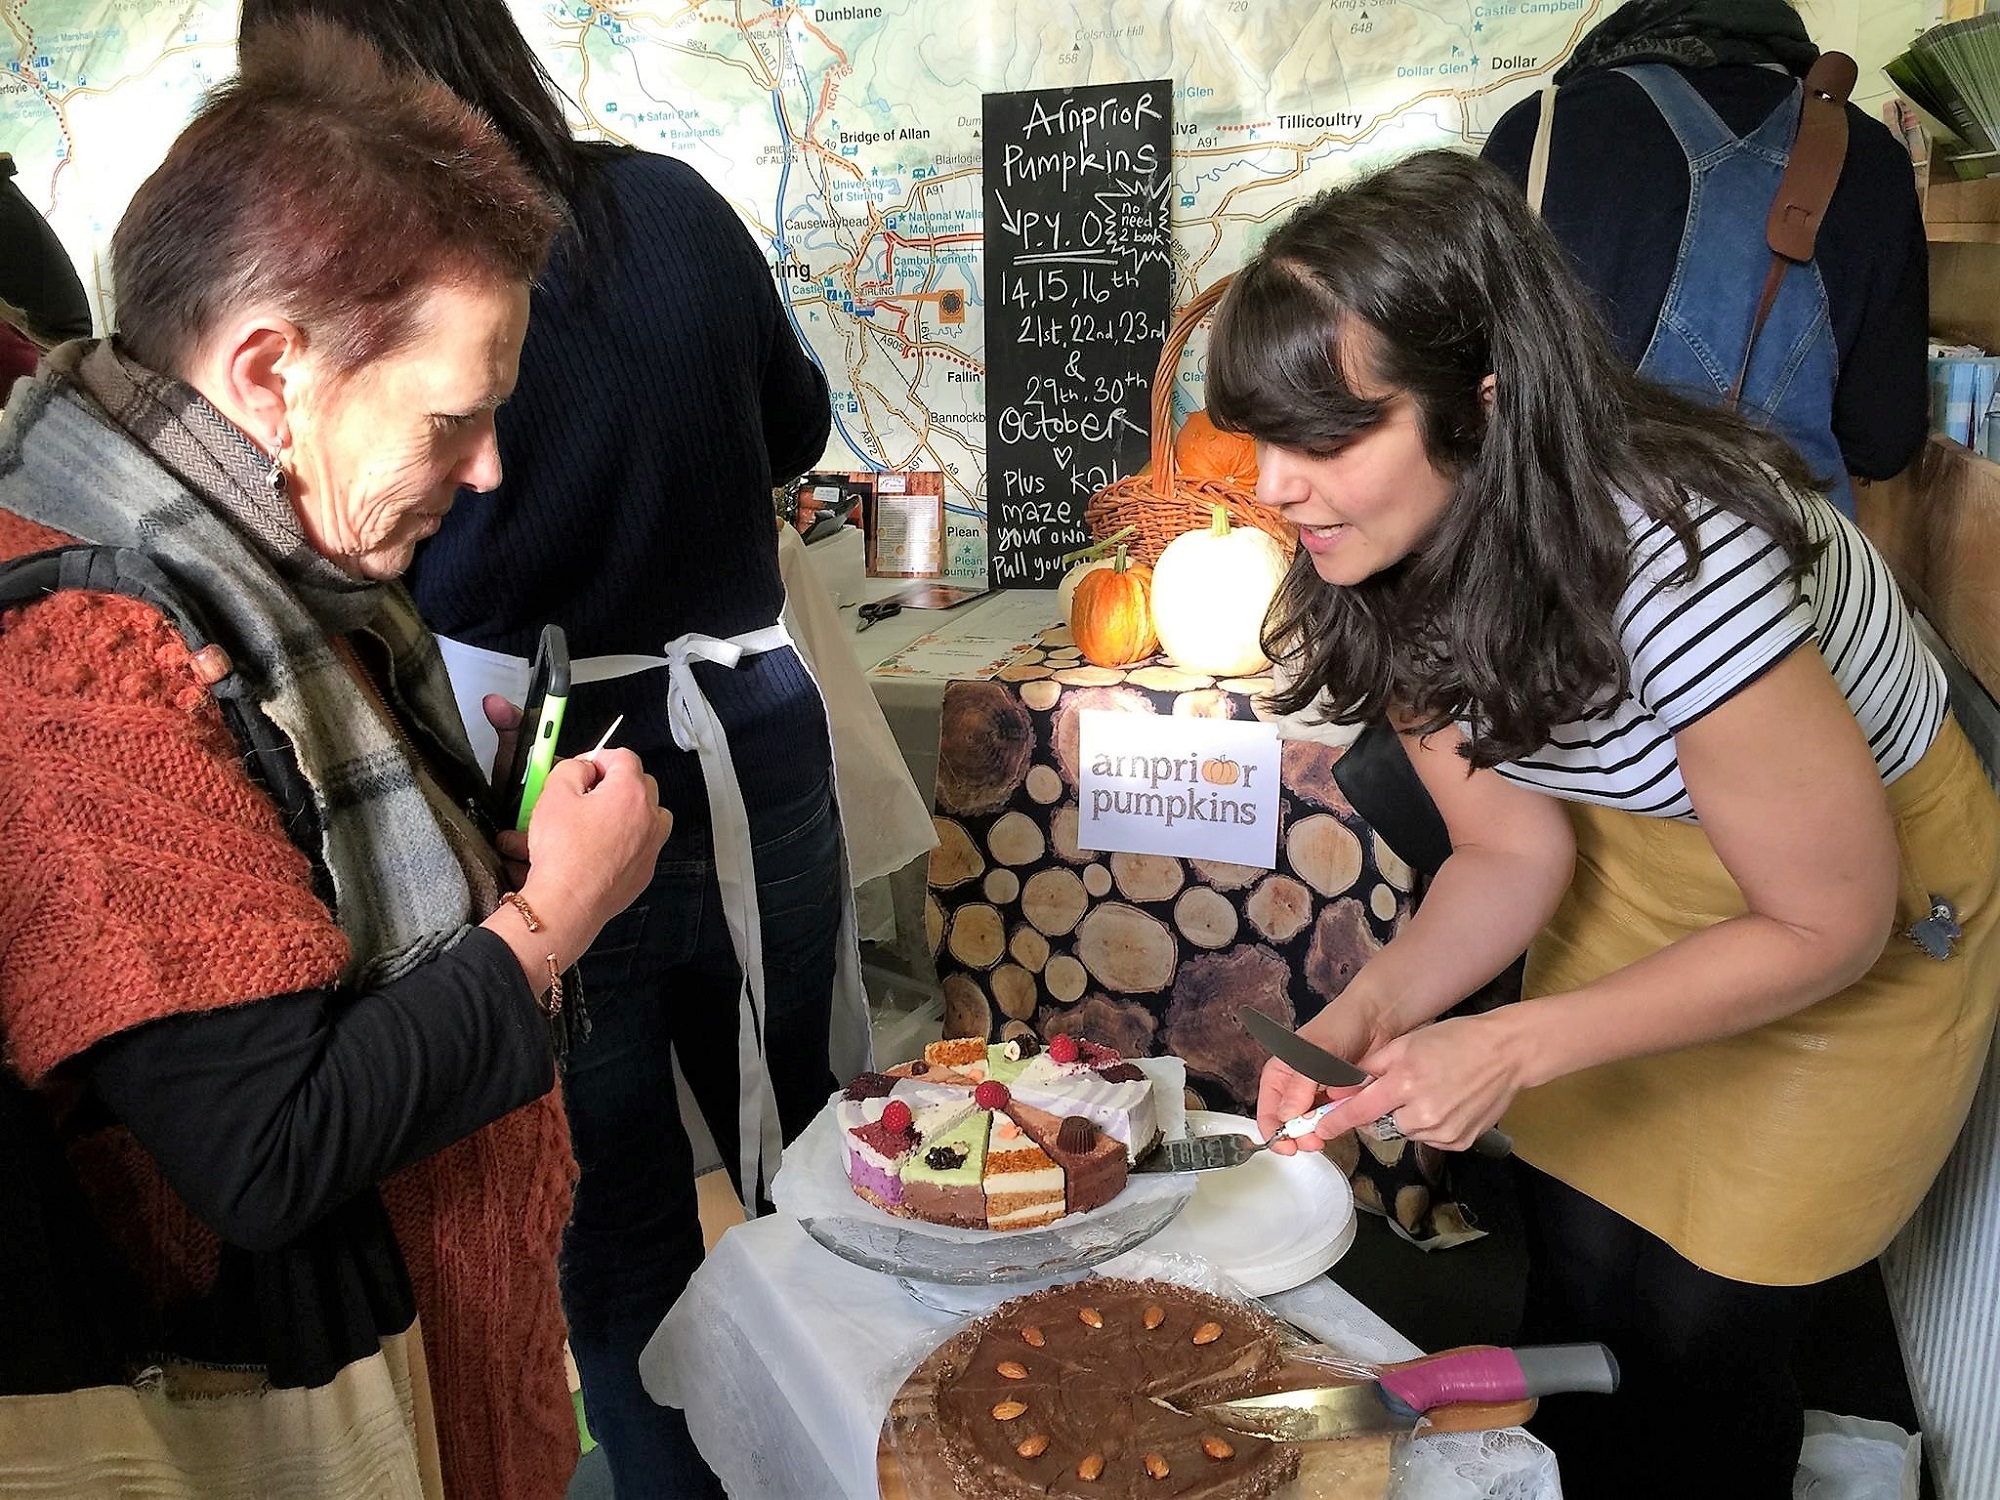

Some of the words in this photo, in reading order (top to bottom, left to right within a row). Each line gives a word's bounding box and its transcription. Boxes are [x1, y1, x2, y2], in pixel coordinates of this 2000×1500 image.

[1227, 1, 1248, 13] 720
[1475, 6, 1517, 18] Castle
[1525, 0, 1583, 14] Campbell
[815, 6, 883, 23] Dunblane
[737, 30, 786, 41] DUNBLANE
[1127, 25, 1145, 40] Hill
[1350, 23, 1373, 35] 648
[686, 38, 708, 51] B824
[757, 42, 779, 71] A9(T)
[1058, 53, 1079, 65] 558
[1491, 55, 1538, 71] Dollar
[1397, 66, 1434, 78] Dollar
[1438, 63, 1469, 75] Glen
[827, 83, 840, 111] NCN
[834, 65, 854, 82] 765
[1186, 86, 1214, 98] Glen
[646, 111, 675, 122] Safari
[678, 109, 700, 120] Park
[1276, 112, 1363, 130] Tillicoultry
[670, 128, 722, 139] Briarlands
[839, 131, 880, 145] Bridge
[883, 129, 897, 141] of
[899, 127, 931, 140] Allan
[671, 142, 697, 150] Farm
[822, 138, 837, 150] A9
[1196, 136, 1218, 149] A91
[763, 144, 798, 155] BRIDGE
[756, 156, 769, 165] OF
[771, 155, 799, 164] ALLAN
[935, 154, 982, 167] Blairlogie
[832, 178, 885, 191] University
[925, 184, 945, 197] A91
[833, 192, 844, 202] of
[846, 191, 884, 203] Stirling
[908, 210, 952, 222] National
[1121, 210, 1153, 228] need
[784, 216, 870, 231] Causewayhead
[909, 222, 965, 235] Monument
[785, 235, 802, 245] J10
[1118, 229, 1129, 242] 2
[1133, 227, 1165, 245] book
[893, 254, 978, 267] Cambuskenneth
[893, 267, 927, 280] Abbey
[792, 285, 823, 296] Castle
[853, 287, 895, 297] STIRLING
[921, 320, 931, 341] A91
[879, 334, 904, 352] A905
[1064, 349, 1086, 383] &
[947, 371, 981, 383] Fallin
[860, 429, 878, 456] A872
[908, 456, 925, 472] A91
[946, 462, 960, 477] A9
[1003, 468, 1046, 498] Plus
[947, 526, 980, 539] Plean
[997, 524, 1047, 551] your
[954, 556, 983, 566] Plean
[992, 551, 1027, 584] Pull
[1091, 787, 1257, 828] pumpkins
